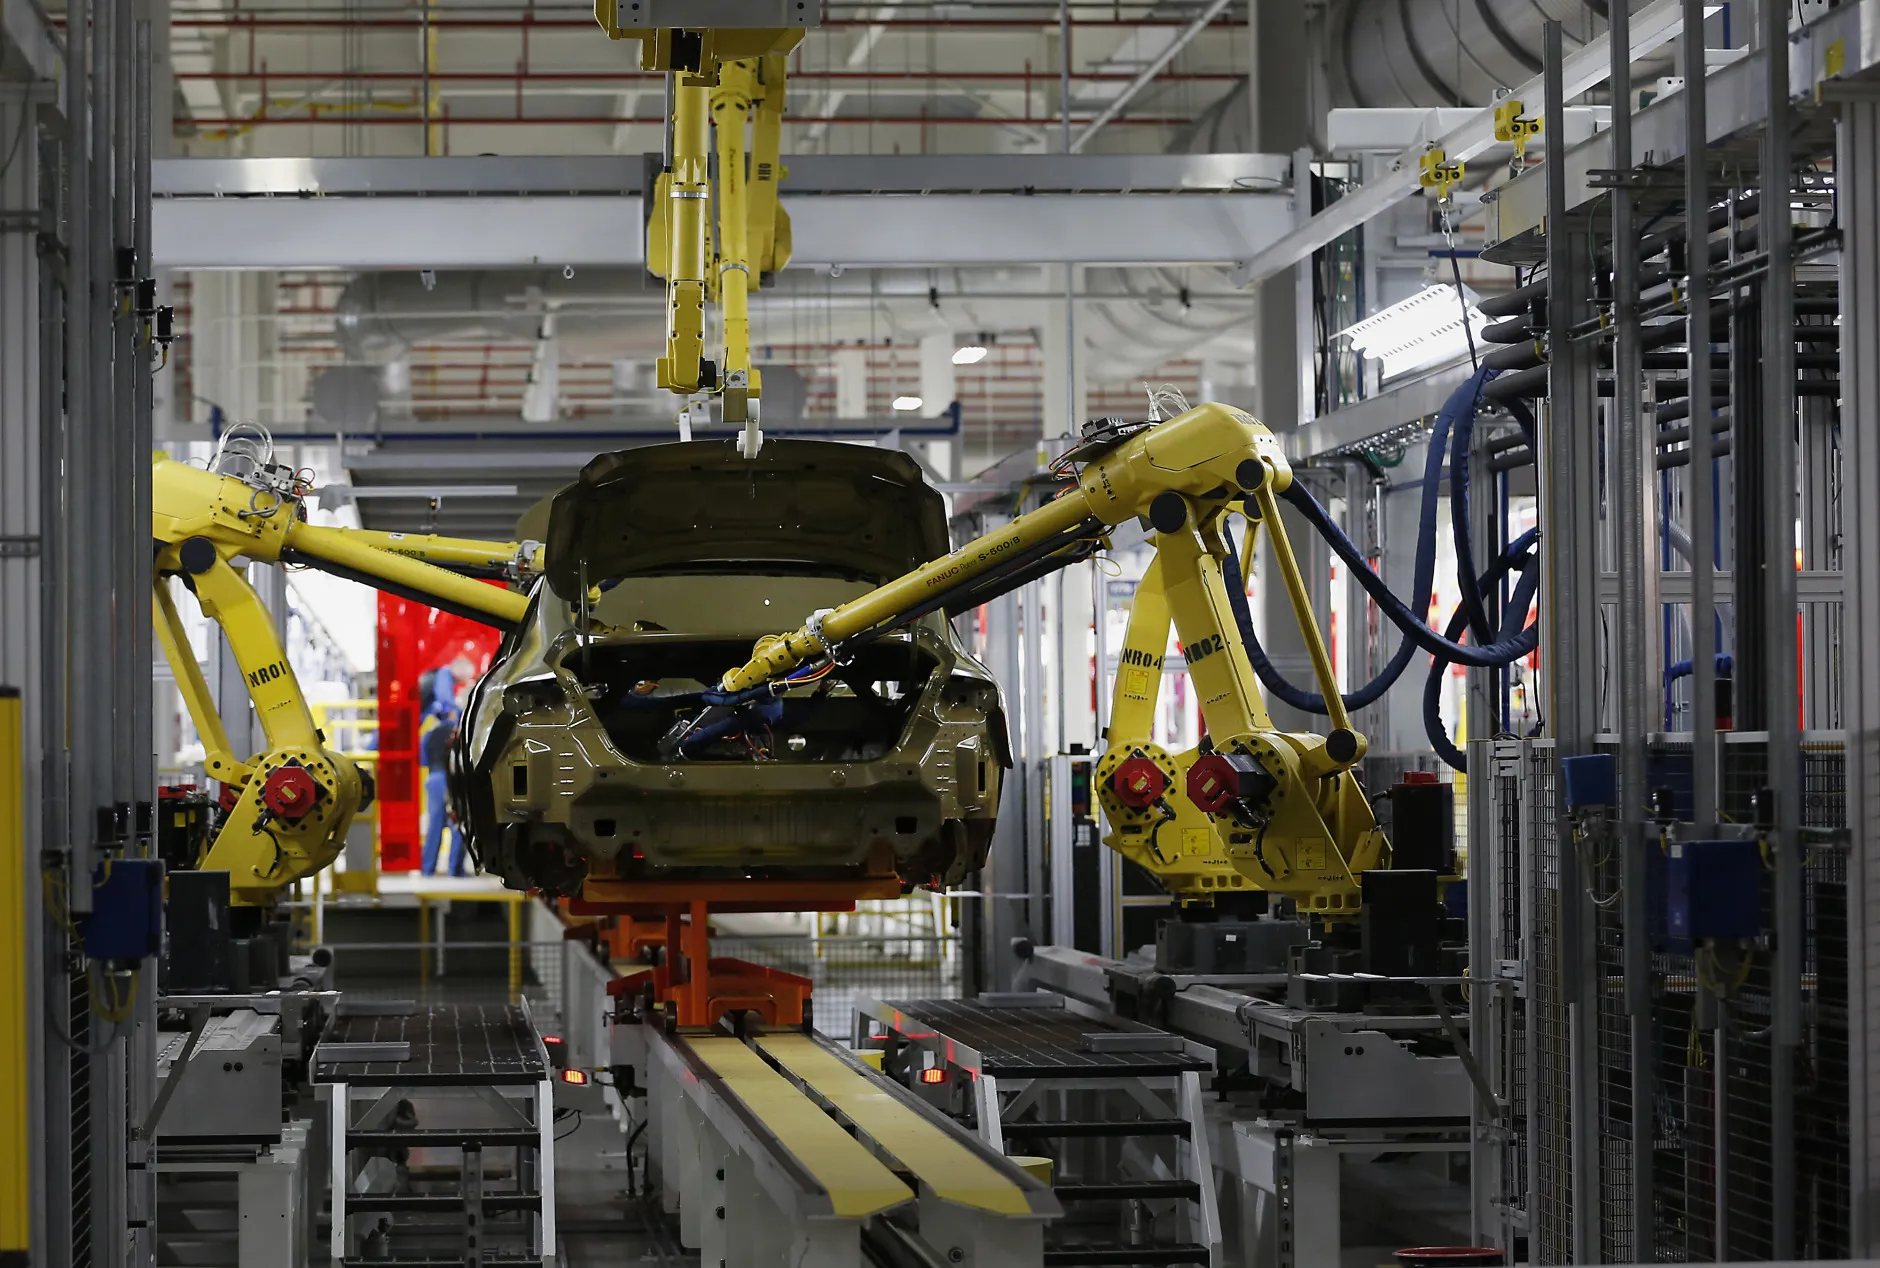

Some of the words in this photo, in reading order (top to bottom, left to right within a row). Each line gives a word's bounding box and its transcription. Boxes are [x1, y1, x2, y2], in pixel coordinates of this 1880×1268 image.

[926, 567, 960, 588] FANUC
[1122, 647, 1165, 670] NR04
[1183, 633, 1225, 666] NR02
[248, 660, 287, 688] NR01
